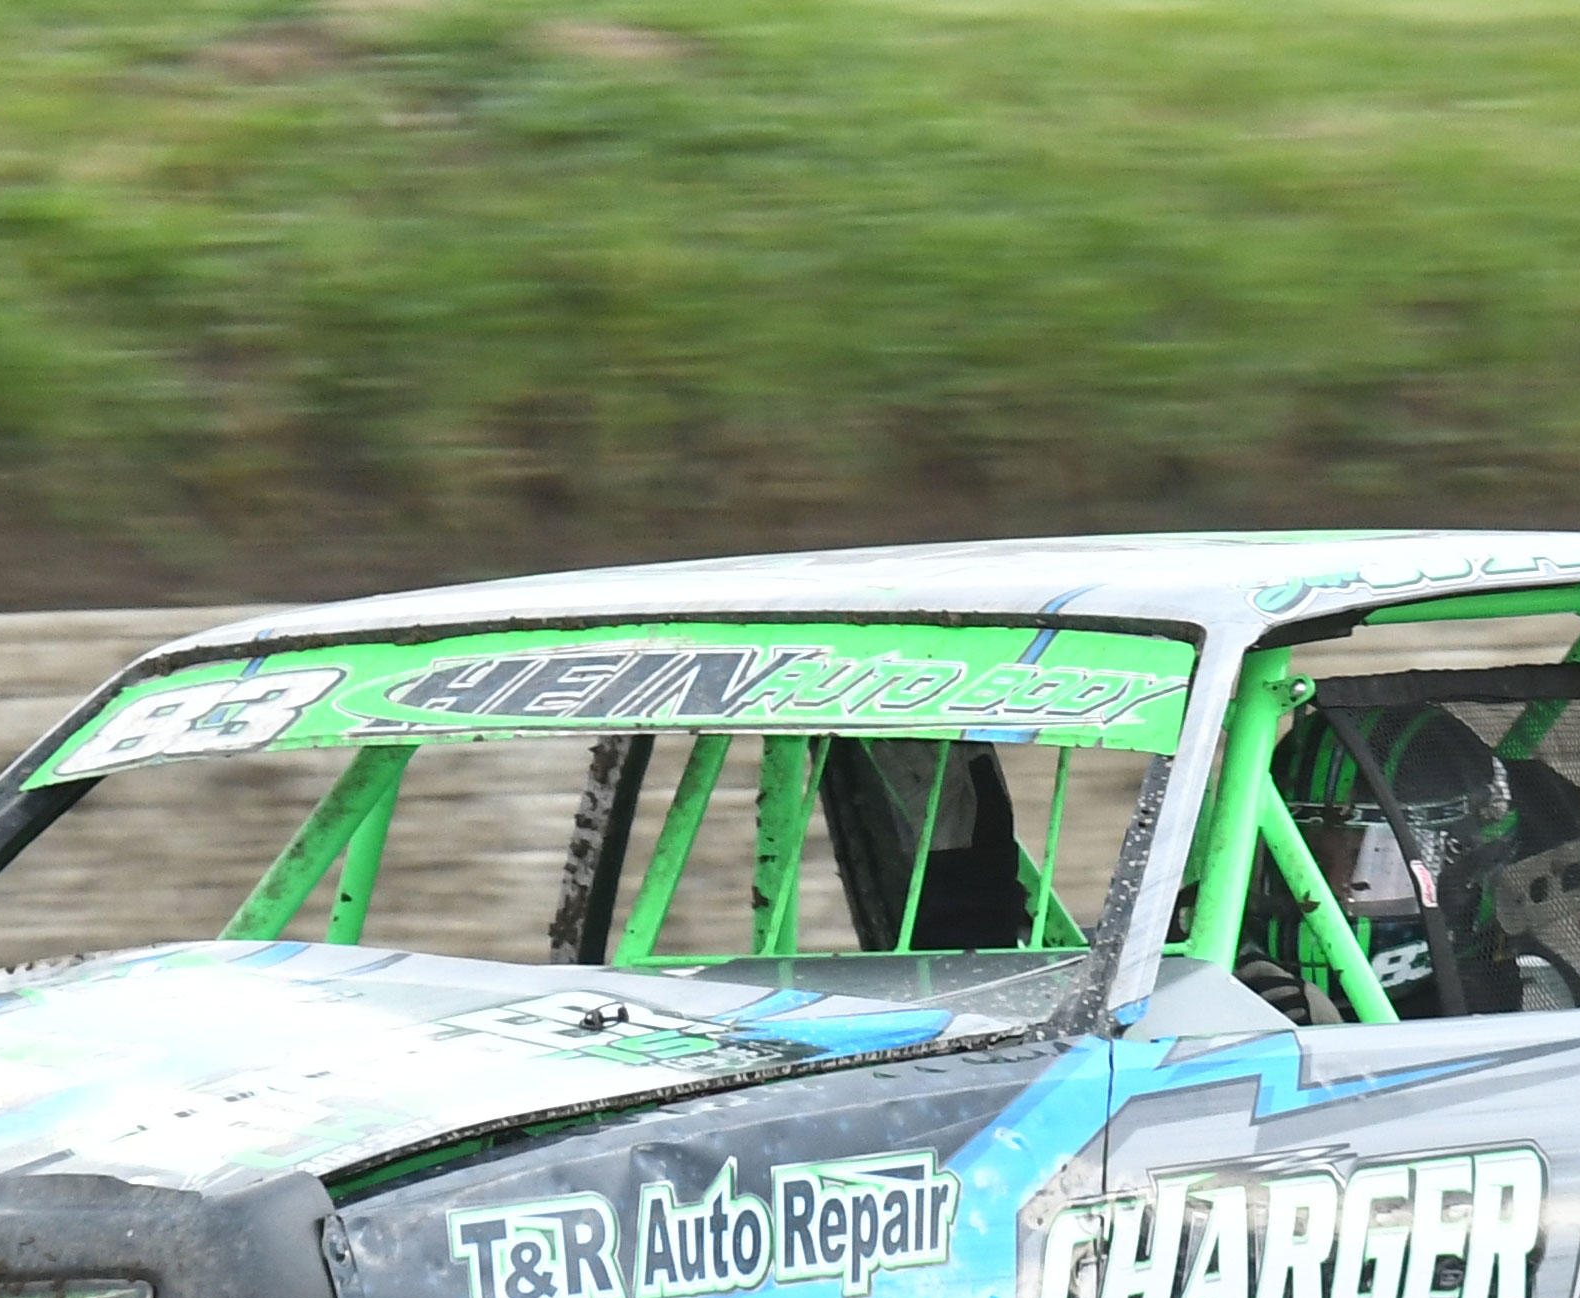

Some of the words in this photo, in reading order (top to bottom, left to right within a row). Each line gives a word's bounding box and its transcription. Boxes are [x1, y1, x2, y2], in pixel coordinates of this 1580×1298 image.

[54, 667, 345, 776] 83
[355, 650, 825, 733] HEIN
[738, 655, 965, 716] AUTO
[945, 664, 1188, 724] BODY
[644, 1197, 758, 1286] Auto
[784, 1178, 950, 1284] Repair
